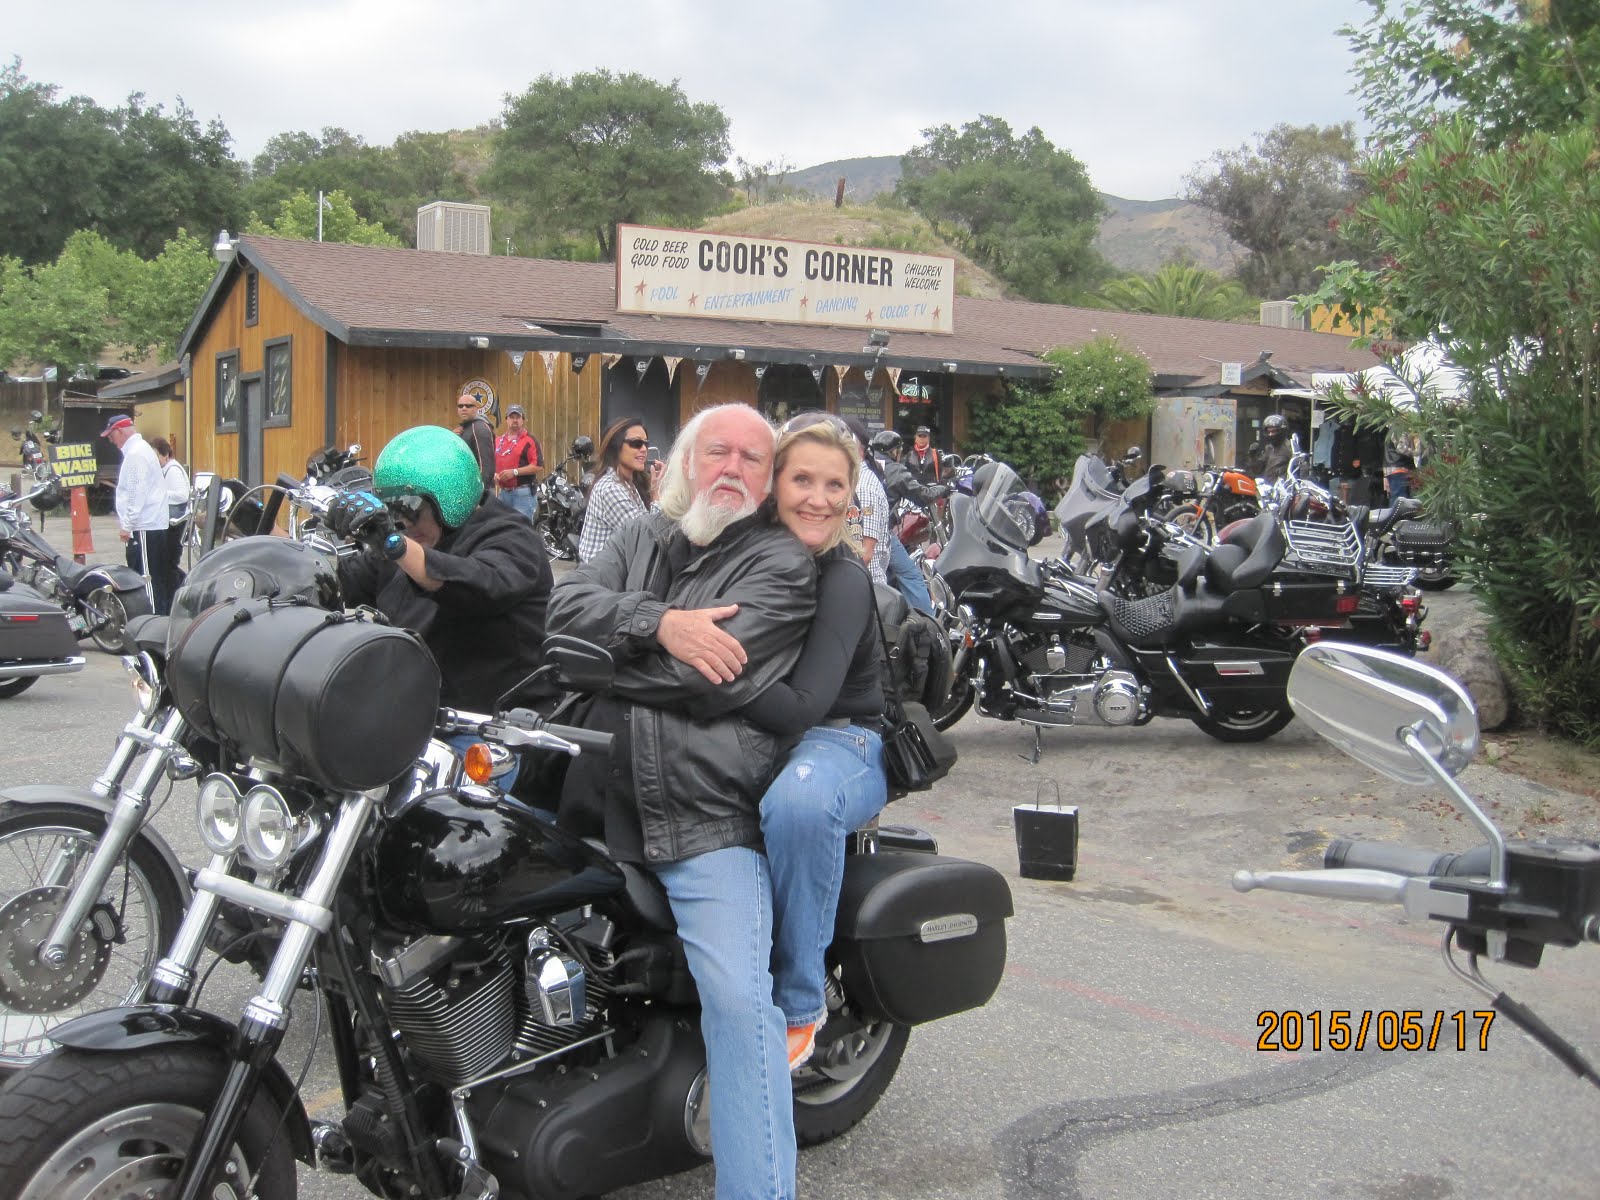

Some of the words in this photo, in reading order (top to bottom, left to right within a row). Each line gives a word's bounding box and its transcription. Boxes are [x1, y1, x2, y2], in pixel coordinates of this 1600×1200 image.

[633, 237, 659, 251] COLD
[662, 240, 688, 254] BEER
[631, 253, 659, 269] GOOD
[662, 256, 690, 269] FOOD
[698, 239, 788, 278] COOK'S
[805, 249, 893, 287] CORNER
[904, 263, 943, 278] CHILDREN
[904, 277, 941, 291] WELCOME
[650, 286, 679, 301] POOL
[704, 288, 794, 310] ENTERTAINMENT
[816, 297, 858, 314] DANCING
[880, 305, 910, 319] COLOR
[914, 303, 927, 316] TV
[56, 444, 92, 459] BIKE
[51, 459, 97, 475] WASH
[60, 474, 95, 487] TODAY
